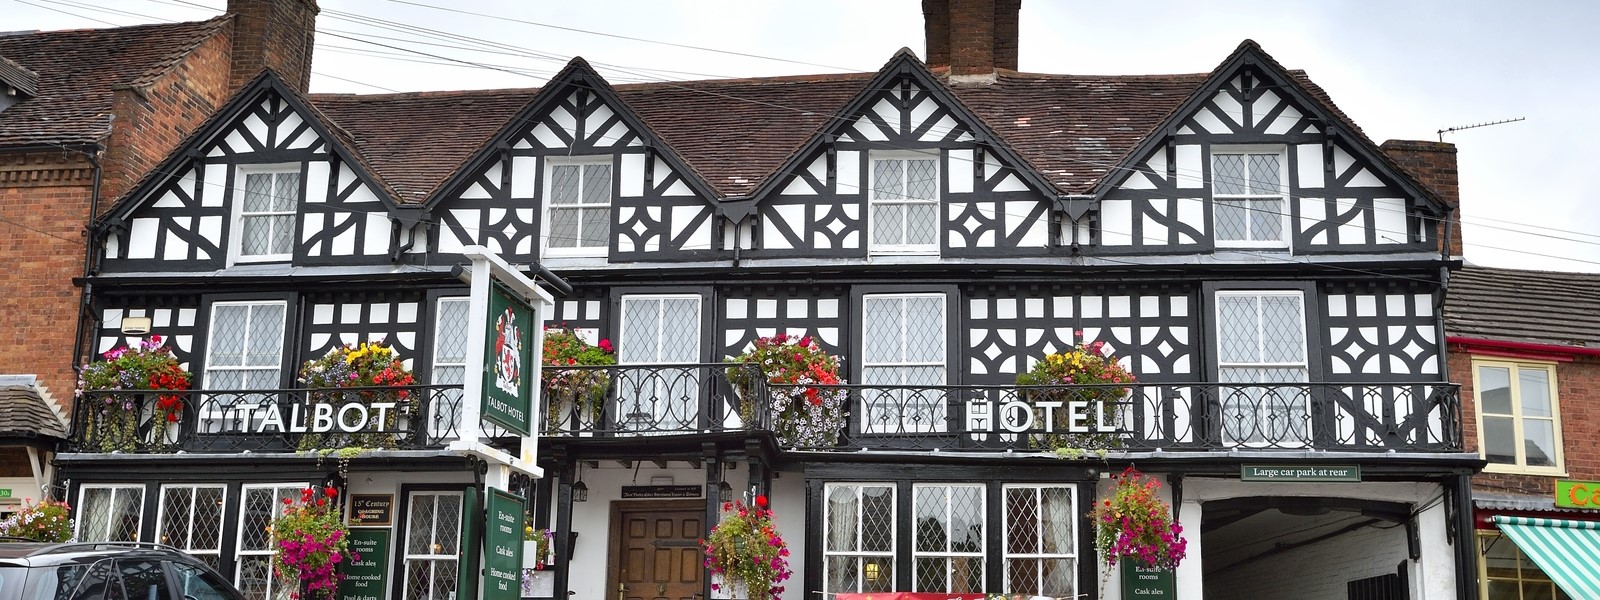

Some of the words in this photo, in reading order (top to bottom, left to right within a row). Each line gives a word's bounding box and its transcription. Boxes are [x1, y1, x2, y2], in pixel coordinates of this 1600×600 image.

[488, 396, 508, 414] TALBOT
[508, 406, 524, 422] HOTEL
[235, 402, 396, 433] TALBOT
[965, 401, 1116, 433] HOTEL
[1253, 468, 1279, 478] Large
[1296, 468, 1317, 477] park
[498, 511, 514, 523] En-suite
[500, 525, 512, 534] rooms
[496, 545, 506, 556] Cask
[491, 568, 502, 578] Home
[503, 571, 516, 580] cooked
[499, 580, 507, 590] food
